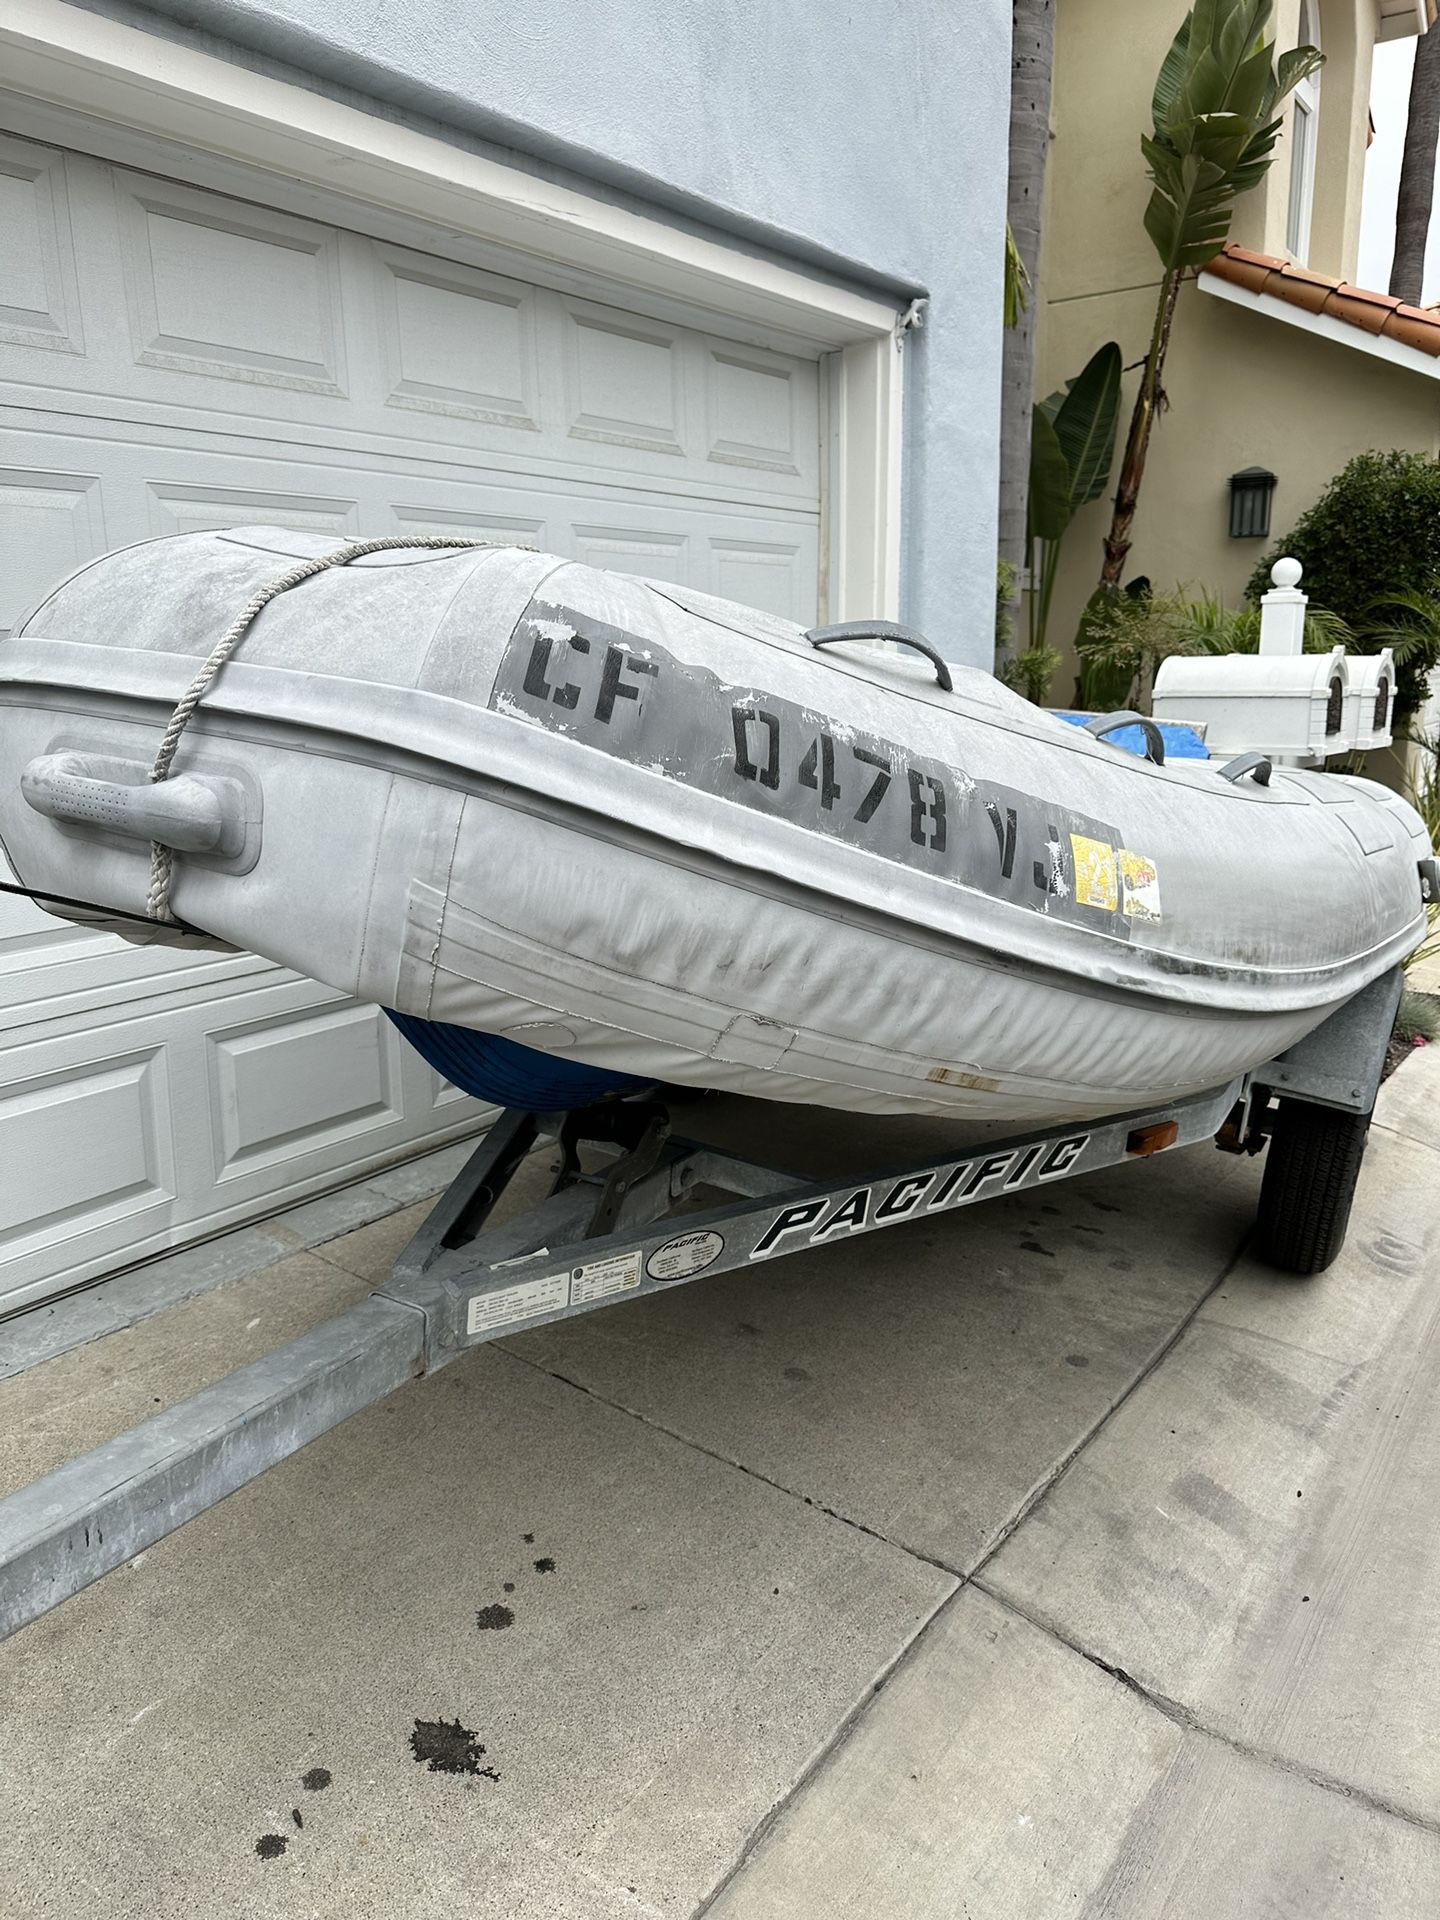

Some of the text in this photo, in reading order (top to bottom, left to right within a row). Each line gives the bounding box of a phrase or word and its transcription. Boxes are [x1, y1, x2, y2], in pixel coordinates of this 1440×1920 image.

[522, 634, 659, 725] CF
[732, 706, 947, 852] 0478
[661, 1232, 711, 1253] PACIFIC
[749, 1133, 1090, 1259] PACIFIC
